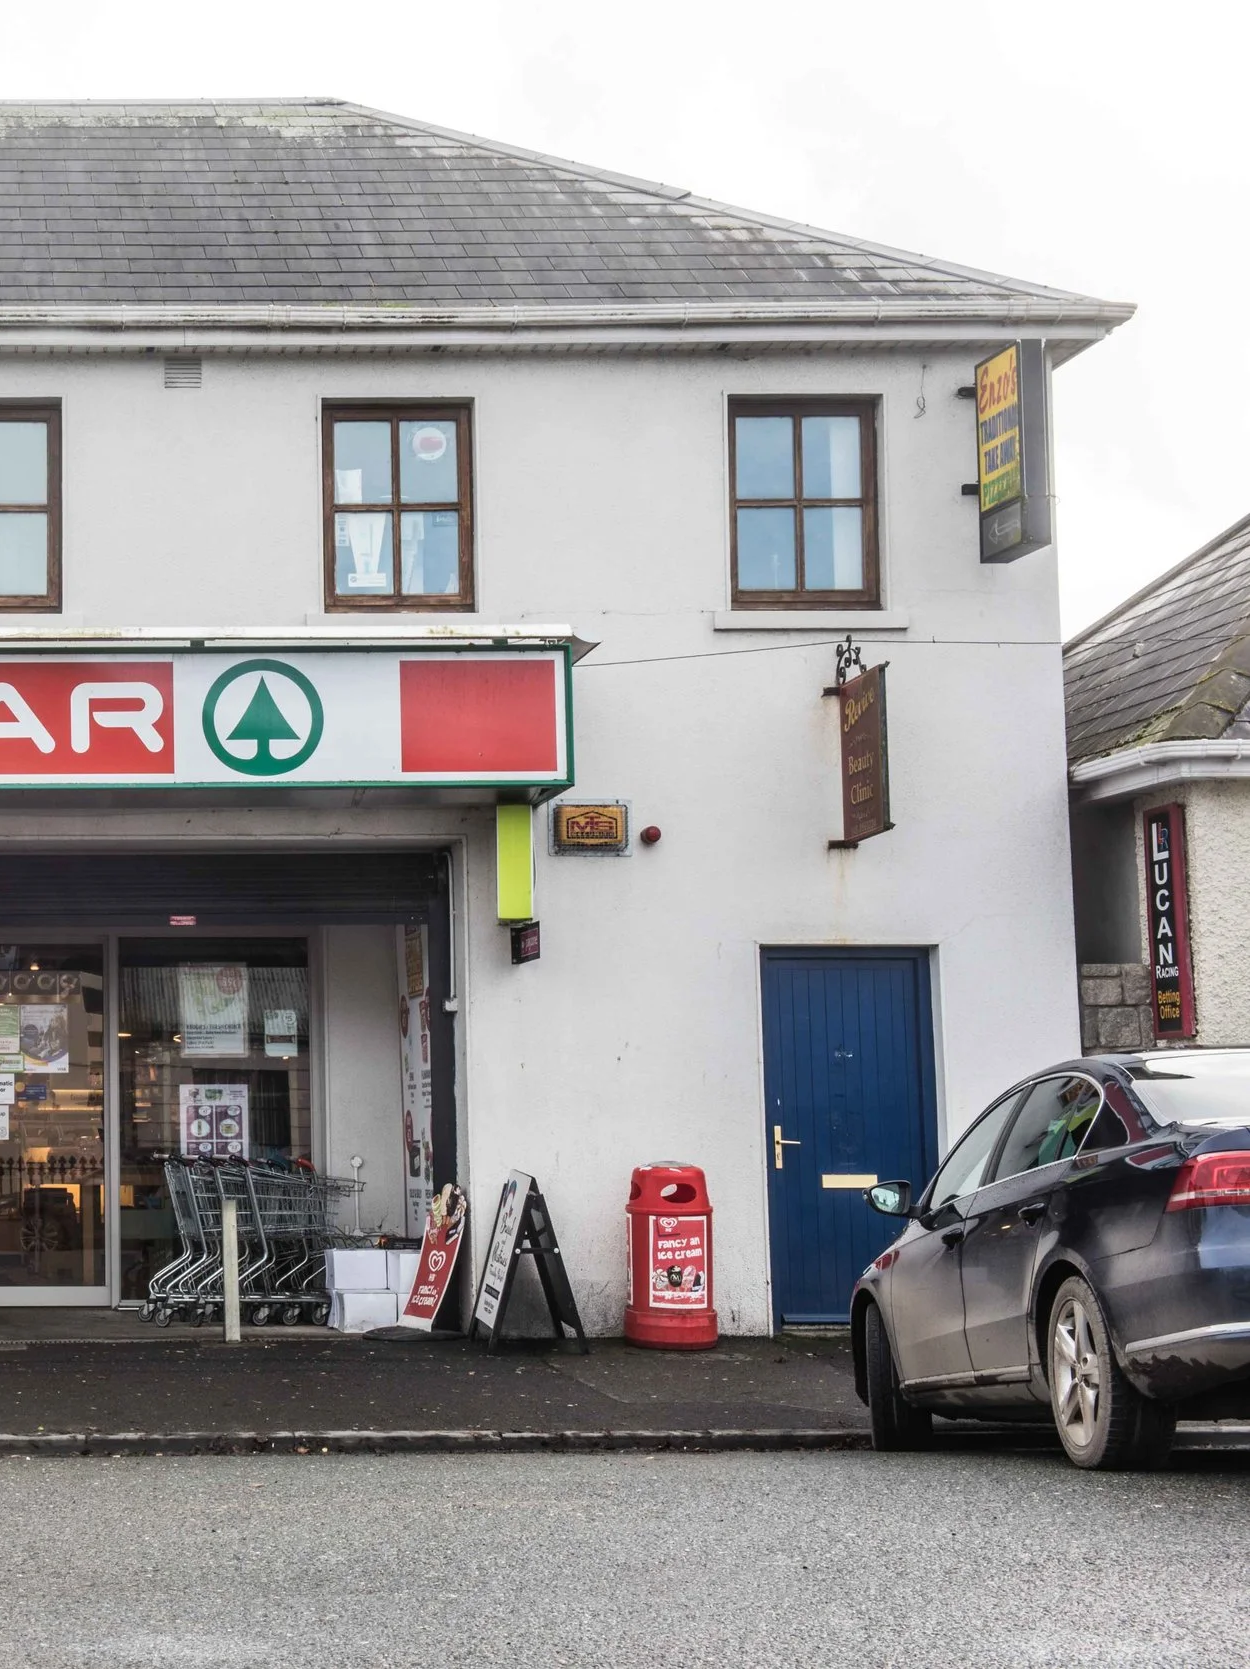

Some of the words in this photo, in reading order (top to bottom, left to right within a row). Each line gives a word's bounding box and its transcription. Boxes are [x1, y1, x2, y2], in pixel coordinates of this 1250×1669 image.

[979, 353, 1017, 414] Enzo's
[984, 443, 999, 476] TAKE
[848, 751, 874, 775] Beauty
[851, 780, 874, 804] Clinic
[1152, 823, 1173, 965] LUCAN
[1158, 989, 1180, 1005] Betting
[1159, 1005, 1180, 1019] Office
[674, 1247, 703, 1260] cream
